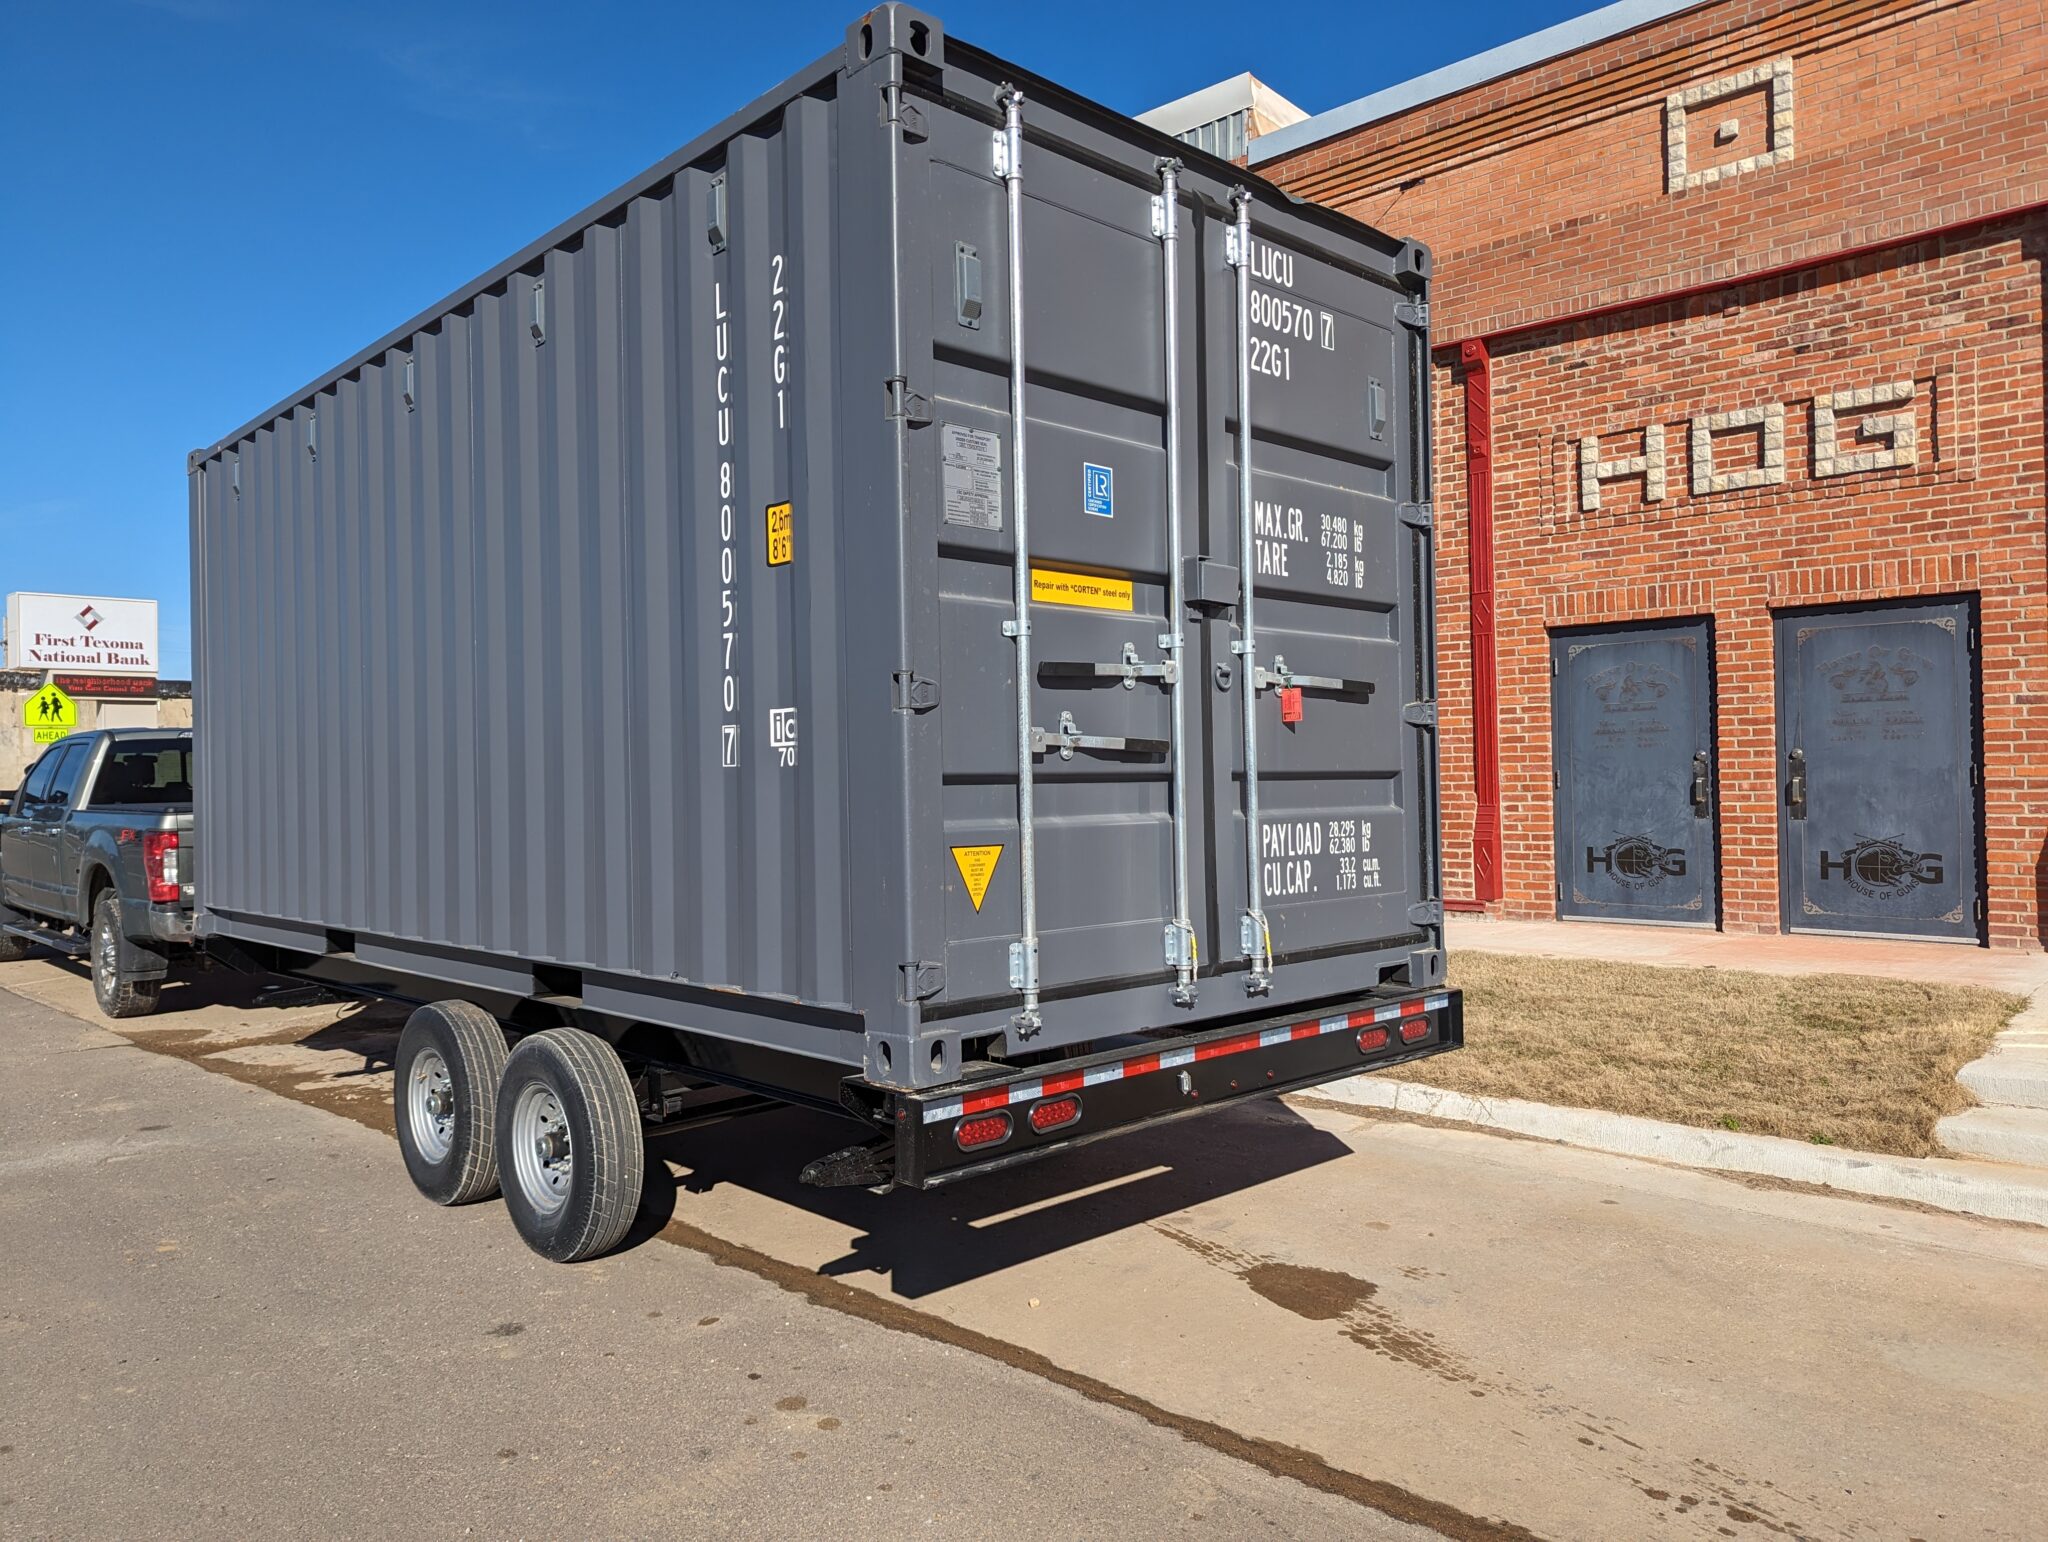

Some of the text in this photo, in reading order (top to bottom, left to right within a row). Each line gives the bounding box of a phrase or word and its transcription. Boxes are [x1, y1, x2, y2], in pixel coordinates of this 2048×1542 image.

[1251, 241, 1293, 288] LUCU
[1250, 290, 1332, 347] 800570 7
[772, 255, 785, 428] 22G1
[1250, 336, 1290, 381] 22G1
[1580, 380, 1916, 511] HOG
[715, 283, 735, 764] LUCU 800570 7
[1320, 513, 1347, 533] 30.480
[1353, 520, 1363, 540] kg
[1321, 531, 1362, 552] 67.200 lb
[1255, 539, 1364, 577] TARE 2.185 kg
[1326, 568, 1363, 588] 4.820 lb
[1033, 579, 1054, 591] Repair
[1055, 583, 1069, 591] with
[1102, 589, 1117, 598] steel
[1118, 590, 1131, 600] only
[34, 633, 144, 650] First Texoma
[29, 649, 150, 665] National Bank
[36, 731, 66, 740] AHEAD
[778, 747, 795, 767] 70
[1262, 820, 1371, 858] PAYLOAD 28.295 kg
[1329, 837, 1370, 854] 62.380 lb
[963, 849, 991, 857] ATTENTION
[1339, 857, 1356, 874] 33.2
[1336, 873, 1357, 891] 1.173
[1607, 869, 1668, 890] HOUSE OF GUNS
[1846, 876, 1920, 900] HOUSE OF GUNS
